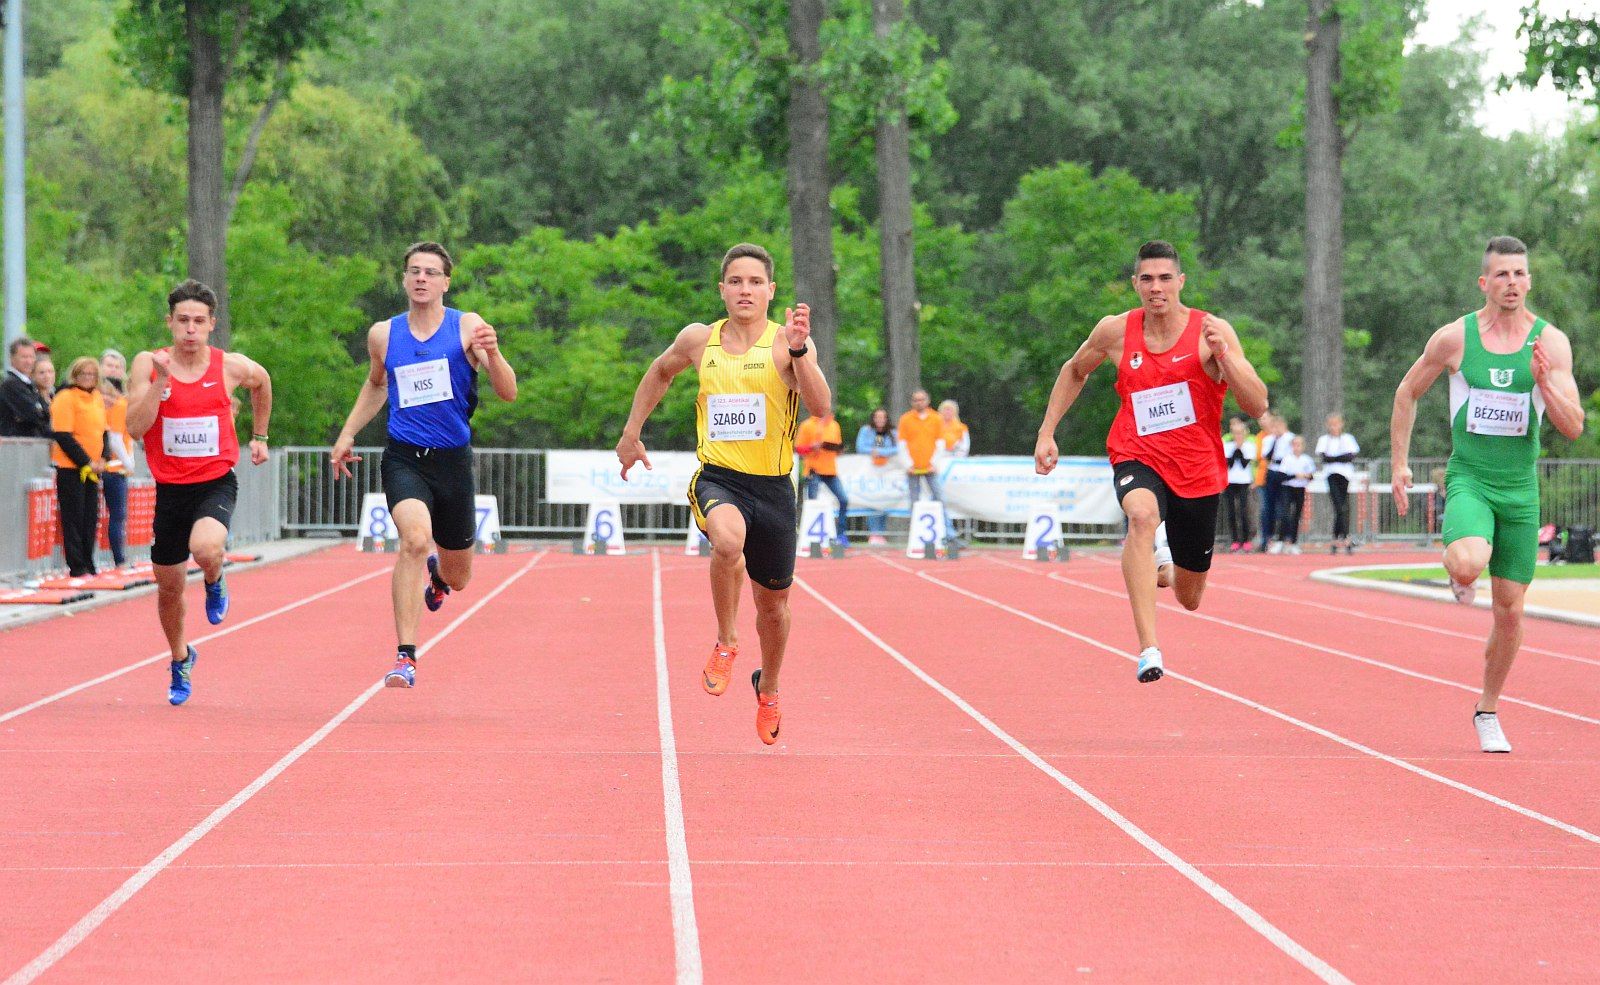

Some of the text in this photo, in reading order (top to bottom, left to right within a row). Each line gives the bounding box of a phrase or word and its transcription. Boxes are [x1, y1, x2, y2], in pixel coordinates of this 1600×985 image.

[413, 379, 434, 392] KISS
[713, 410, 757, 426] SZABÓ D
[1148, 400, 1176, 419] MÁTÉ
[1474, 405, 1523, 423] BÉZSENYI
[174, 432, 208, 444] KÁLLAI
[370, 507, 387, 538] 8
[475, 508, 491, 540] 7
[595, 510, 614, 541] 6
[807, 512, 828, 545] 4
[919, 514, 937, 545] 3
[1035, 515, 1054, 547] 2
